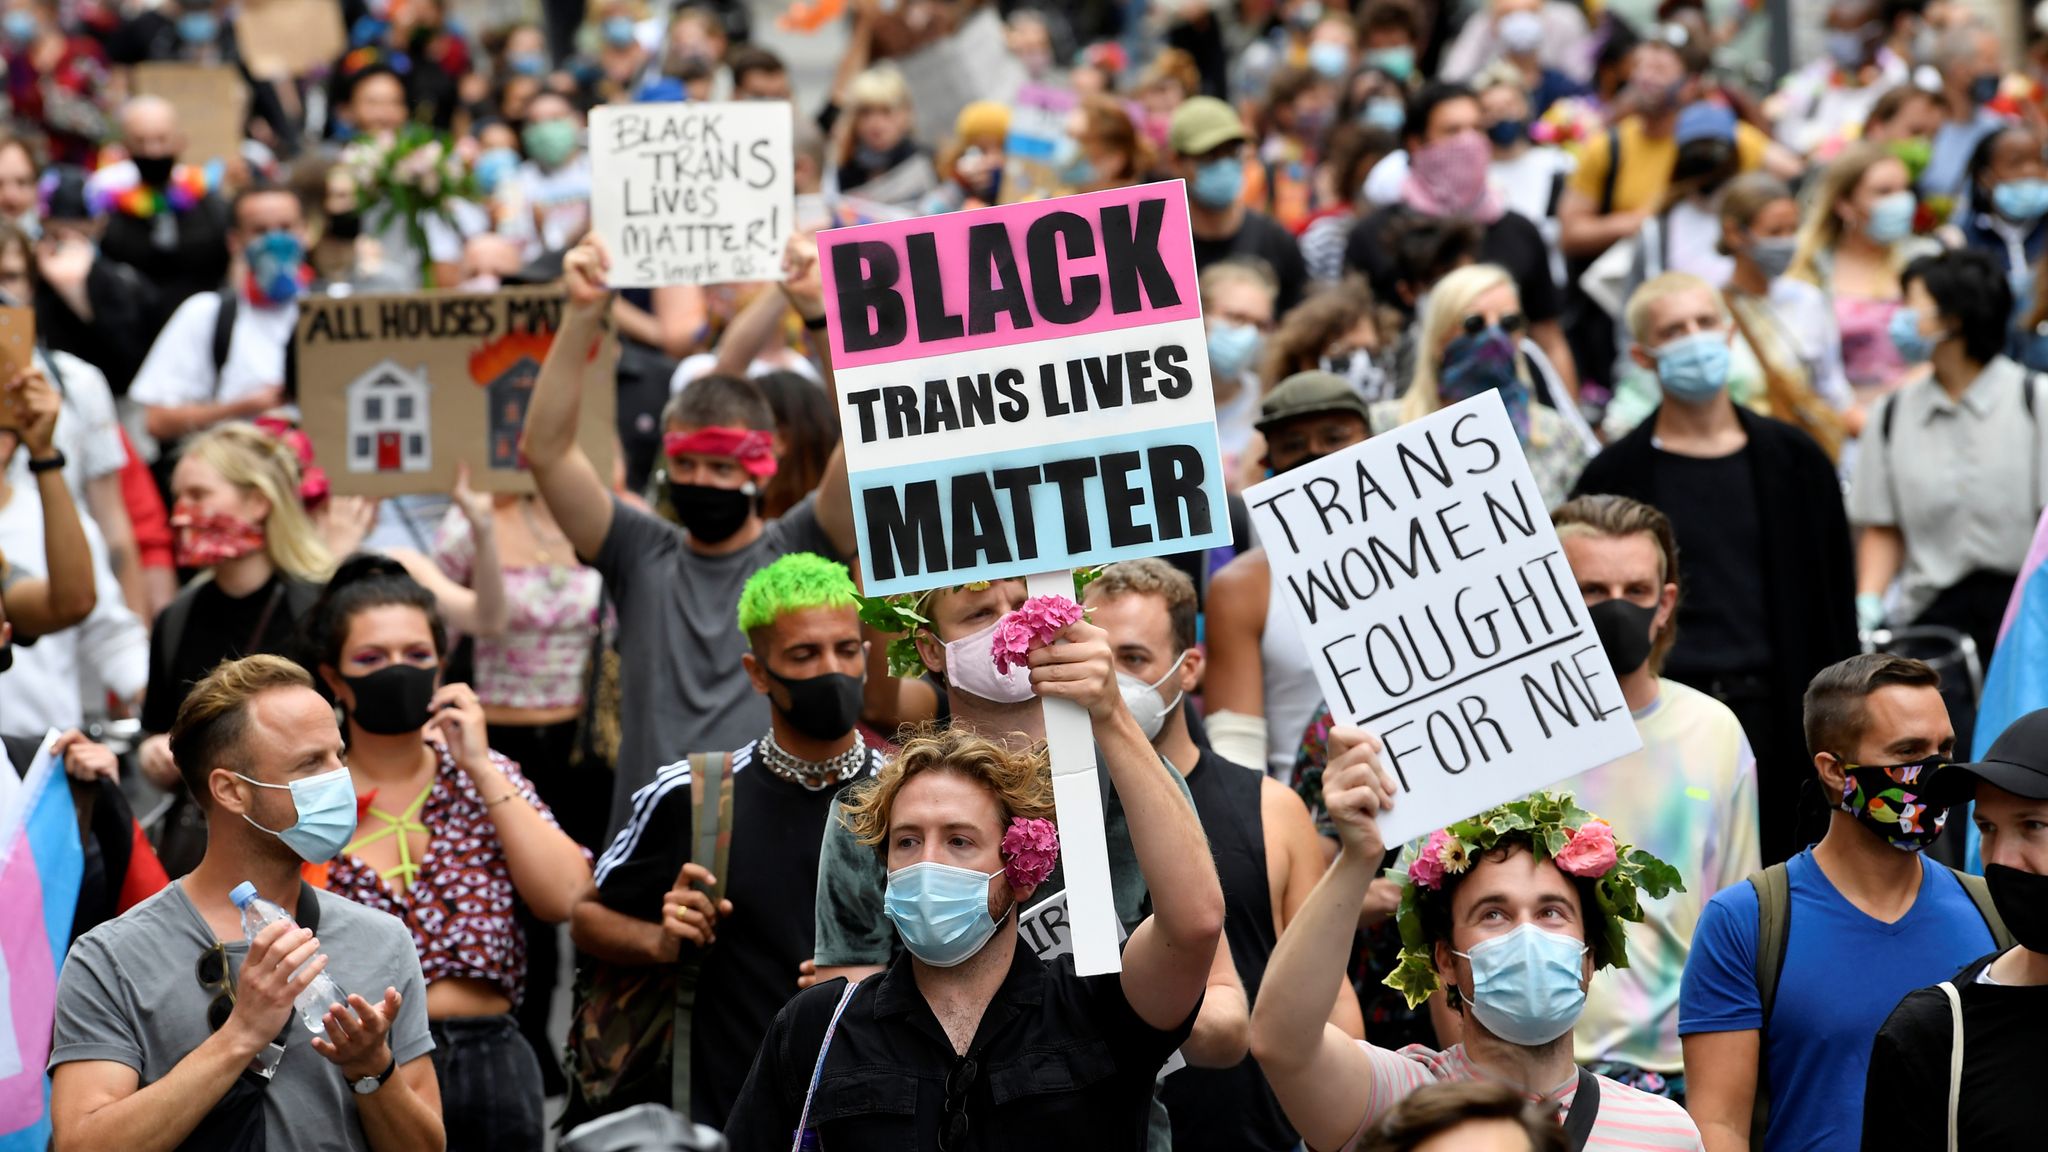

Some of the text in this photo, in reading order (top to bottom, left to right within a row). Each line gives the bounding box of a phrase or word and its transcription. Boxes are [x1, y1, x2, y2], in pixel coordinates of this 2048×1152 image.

[611, 114, 723, 154] BLACK
[637, 139, 776, 190] TRANS
[622, 205, 778, 257] MATTER!
[831, 198, 1183, 354] BLACK
[379, 299, 496, 339] HOUSES
[847, 344, 1193, 444] TRANS LIVES
[862, 443, 1214, 582] MATTER
[1252, 413, 1501, 554] TRANS
[1287, 479, 1537, 625] WOMEN
[1321, 550, 1579, 715] FOUGHT
[1380, 644, 1624, 793] FOR ME
